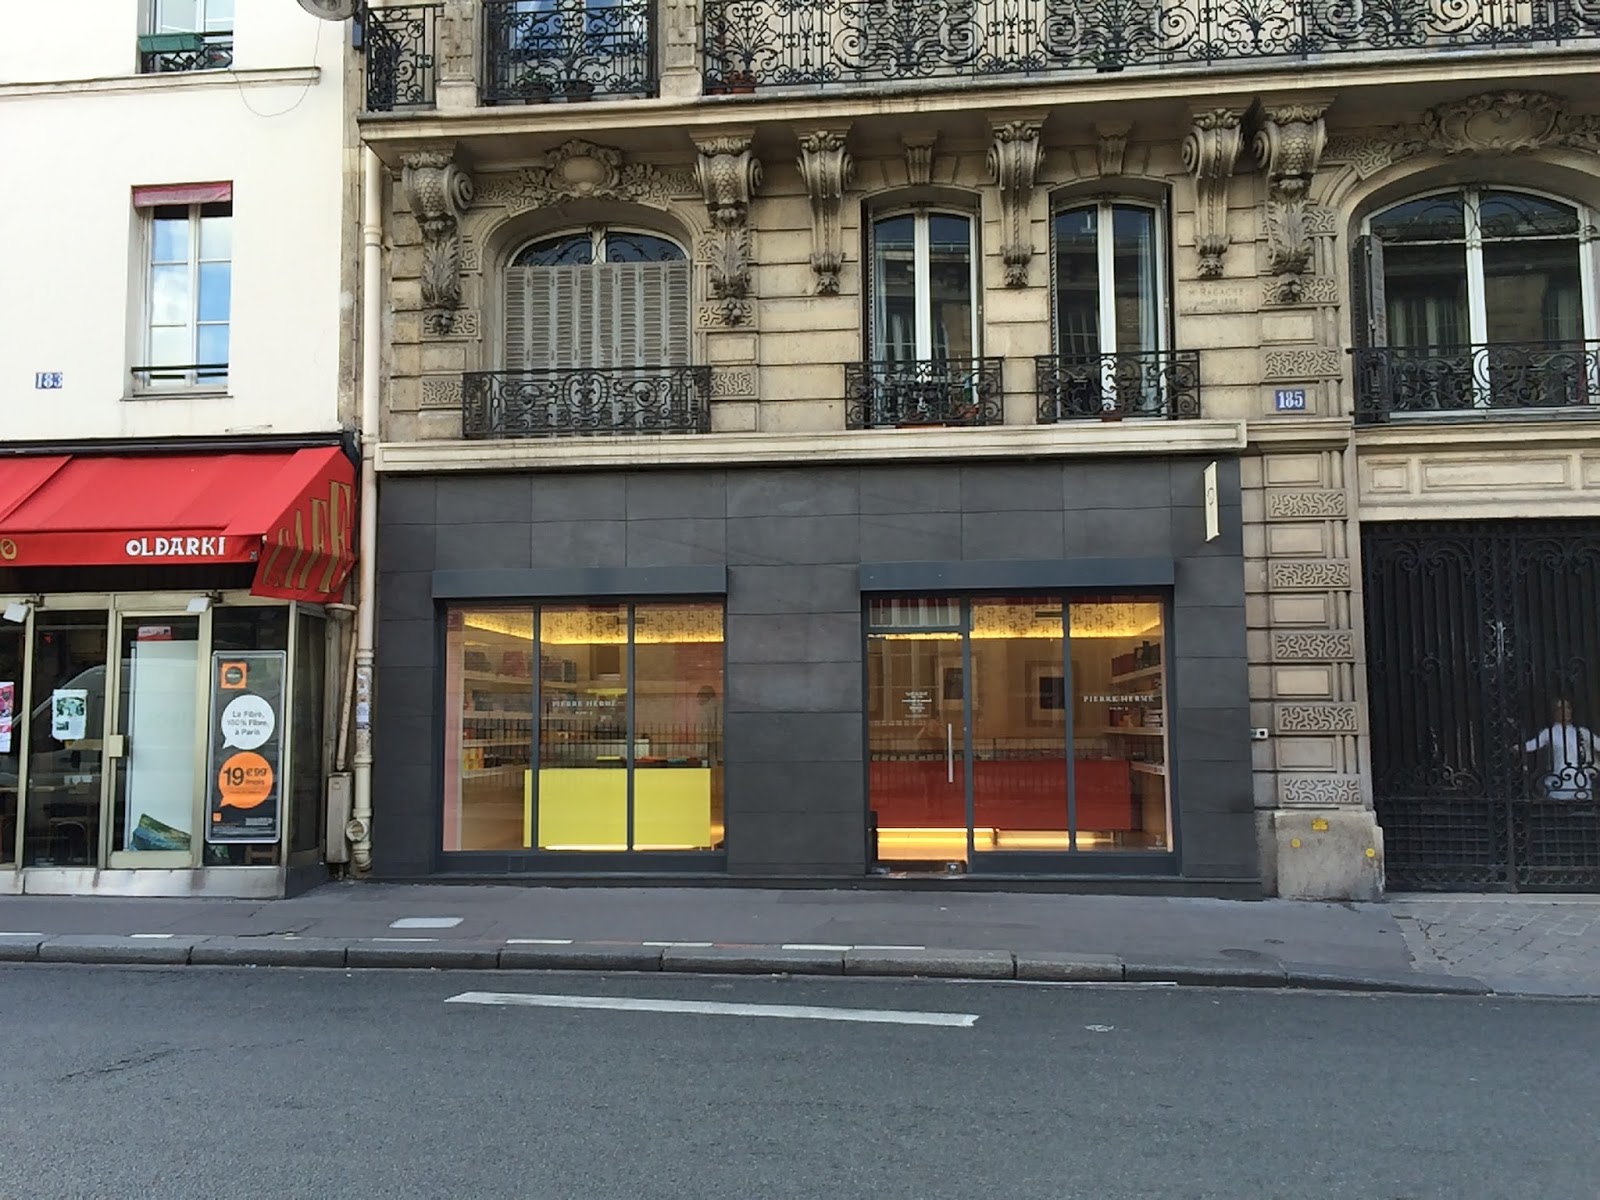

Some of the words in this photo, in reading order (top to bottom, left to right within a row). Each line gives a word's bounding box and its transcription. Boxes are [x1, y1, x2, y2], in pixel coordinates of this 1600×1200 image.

[38, 371, 63, 389] 183
[1278, 390, 1304, 409] 185
[126, 536, 227, 556] OLDARKI
[232, 710, 242, 718] La
